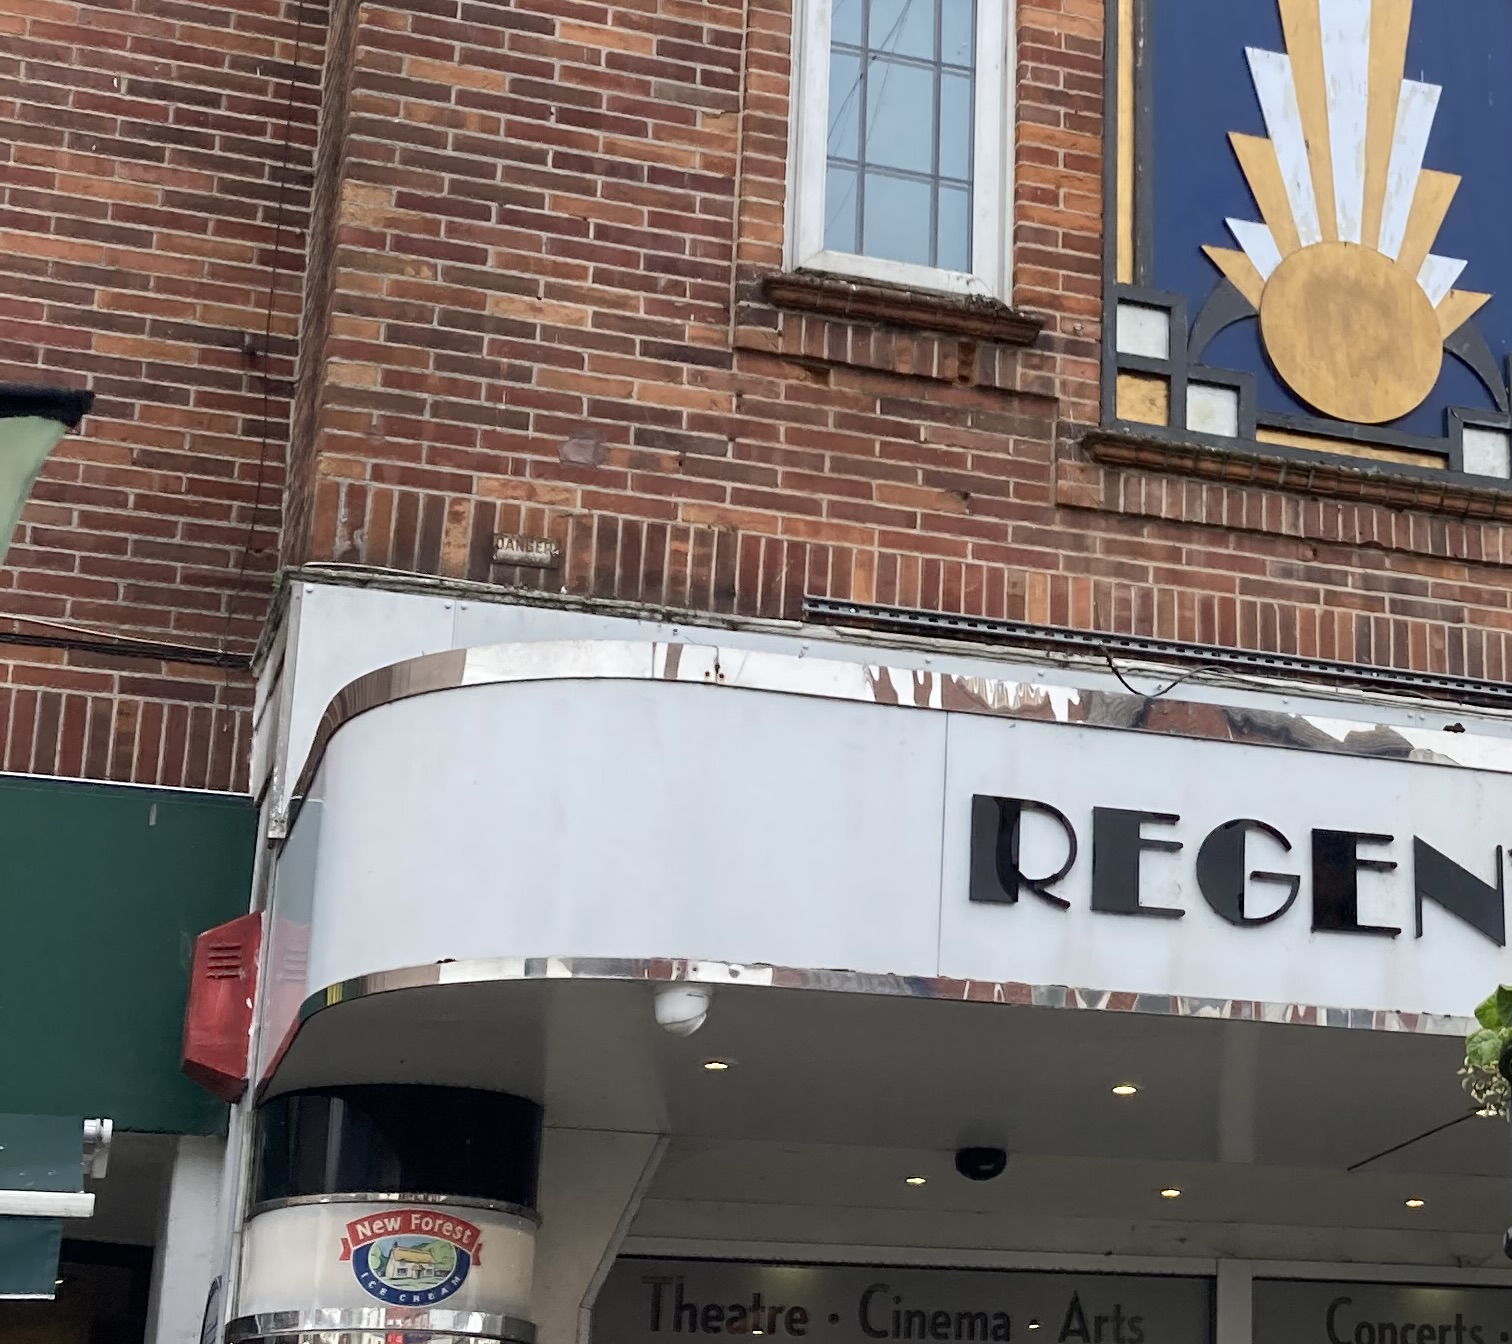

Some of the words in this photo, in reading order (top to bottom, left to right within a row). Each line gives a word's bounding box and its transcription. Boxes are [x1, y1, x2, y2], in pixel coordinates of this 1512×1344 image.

[355, 1216, 401, 1240] New
[411, 1213, 472, 1244] Forest
[361, 1272, 388, 1296] ICE
[399, 1277, 461, 1302] CREAM
[641, 1275, 809, 1337] Theatre
[858, 1282, 1012, 1342] Cinema
[1057, 1290, 1145, 1344] Arts
